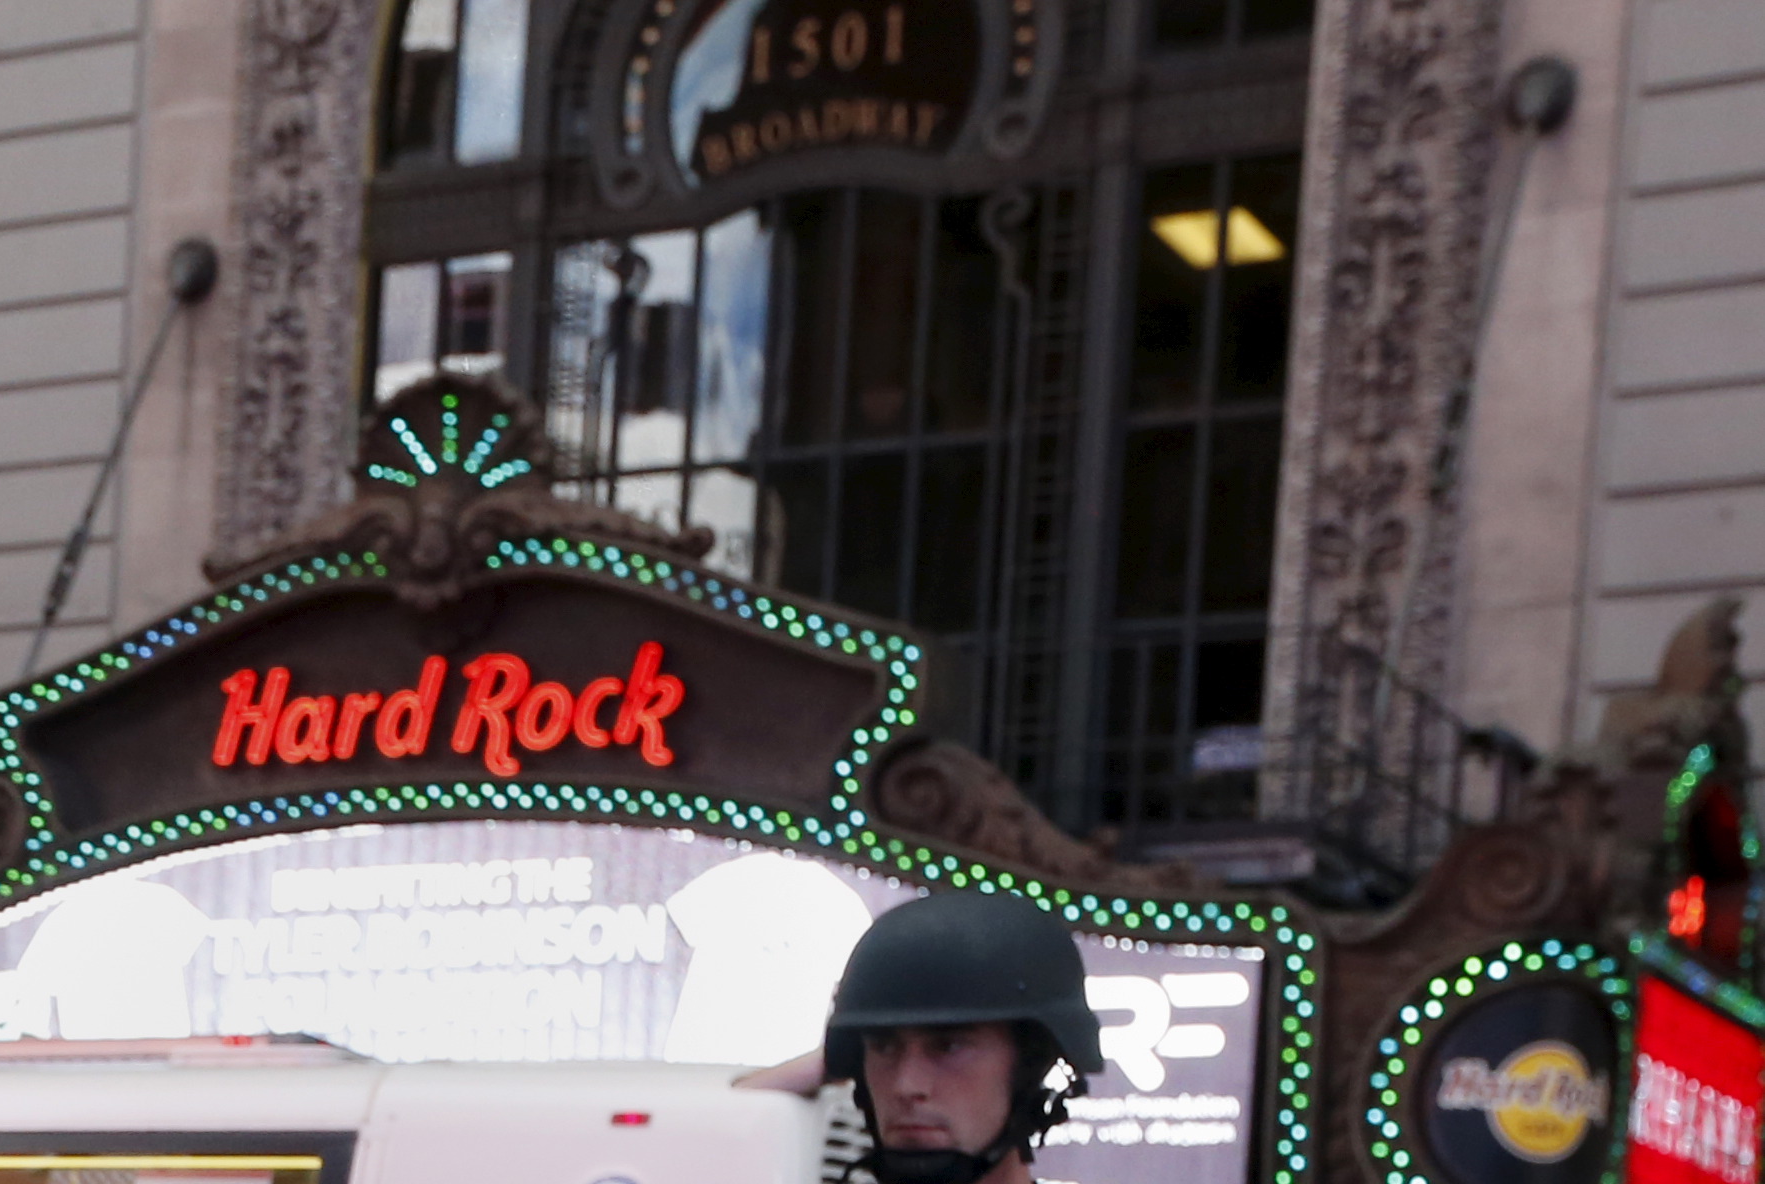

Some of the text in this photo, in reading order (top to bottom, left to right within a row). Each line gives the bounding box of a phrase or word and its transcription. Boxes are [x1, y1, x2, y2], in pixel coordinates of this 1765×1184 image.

[751, 4, 907, 85] 1501
[211, 640, 686, 778] Hard Rock
